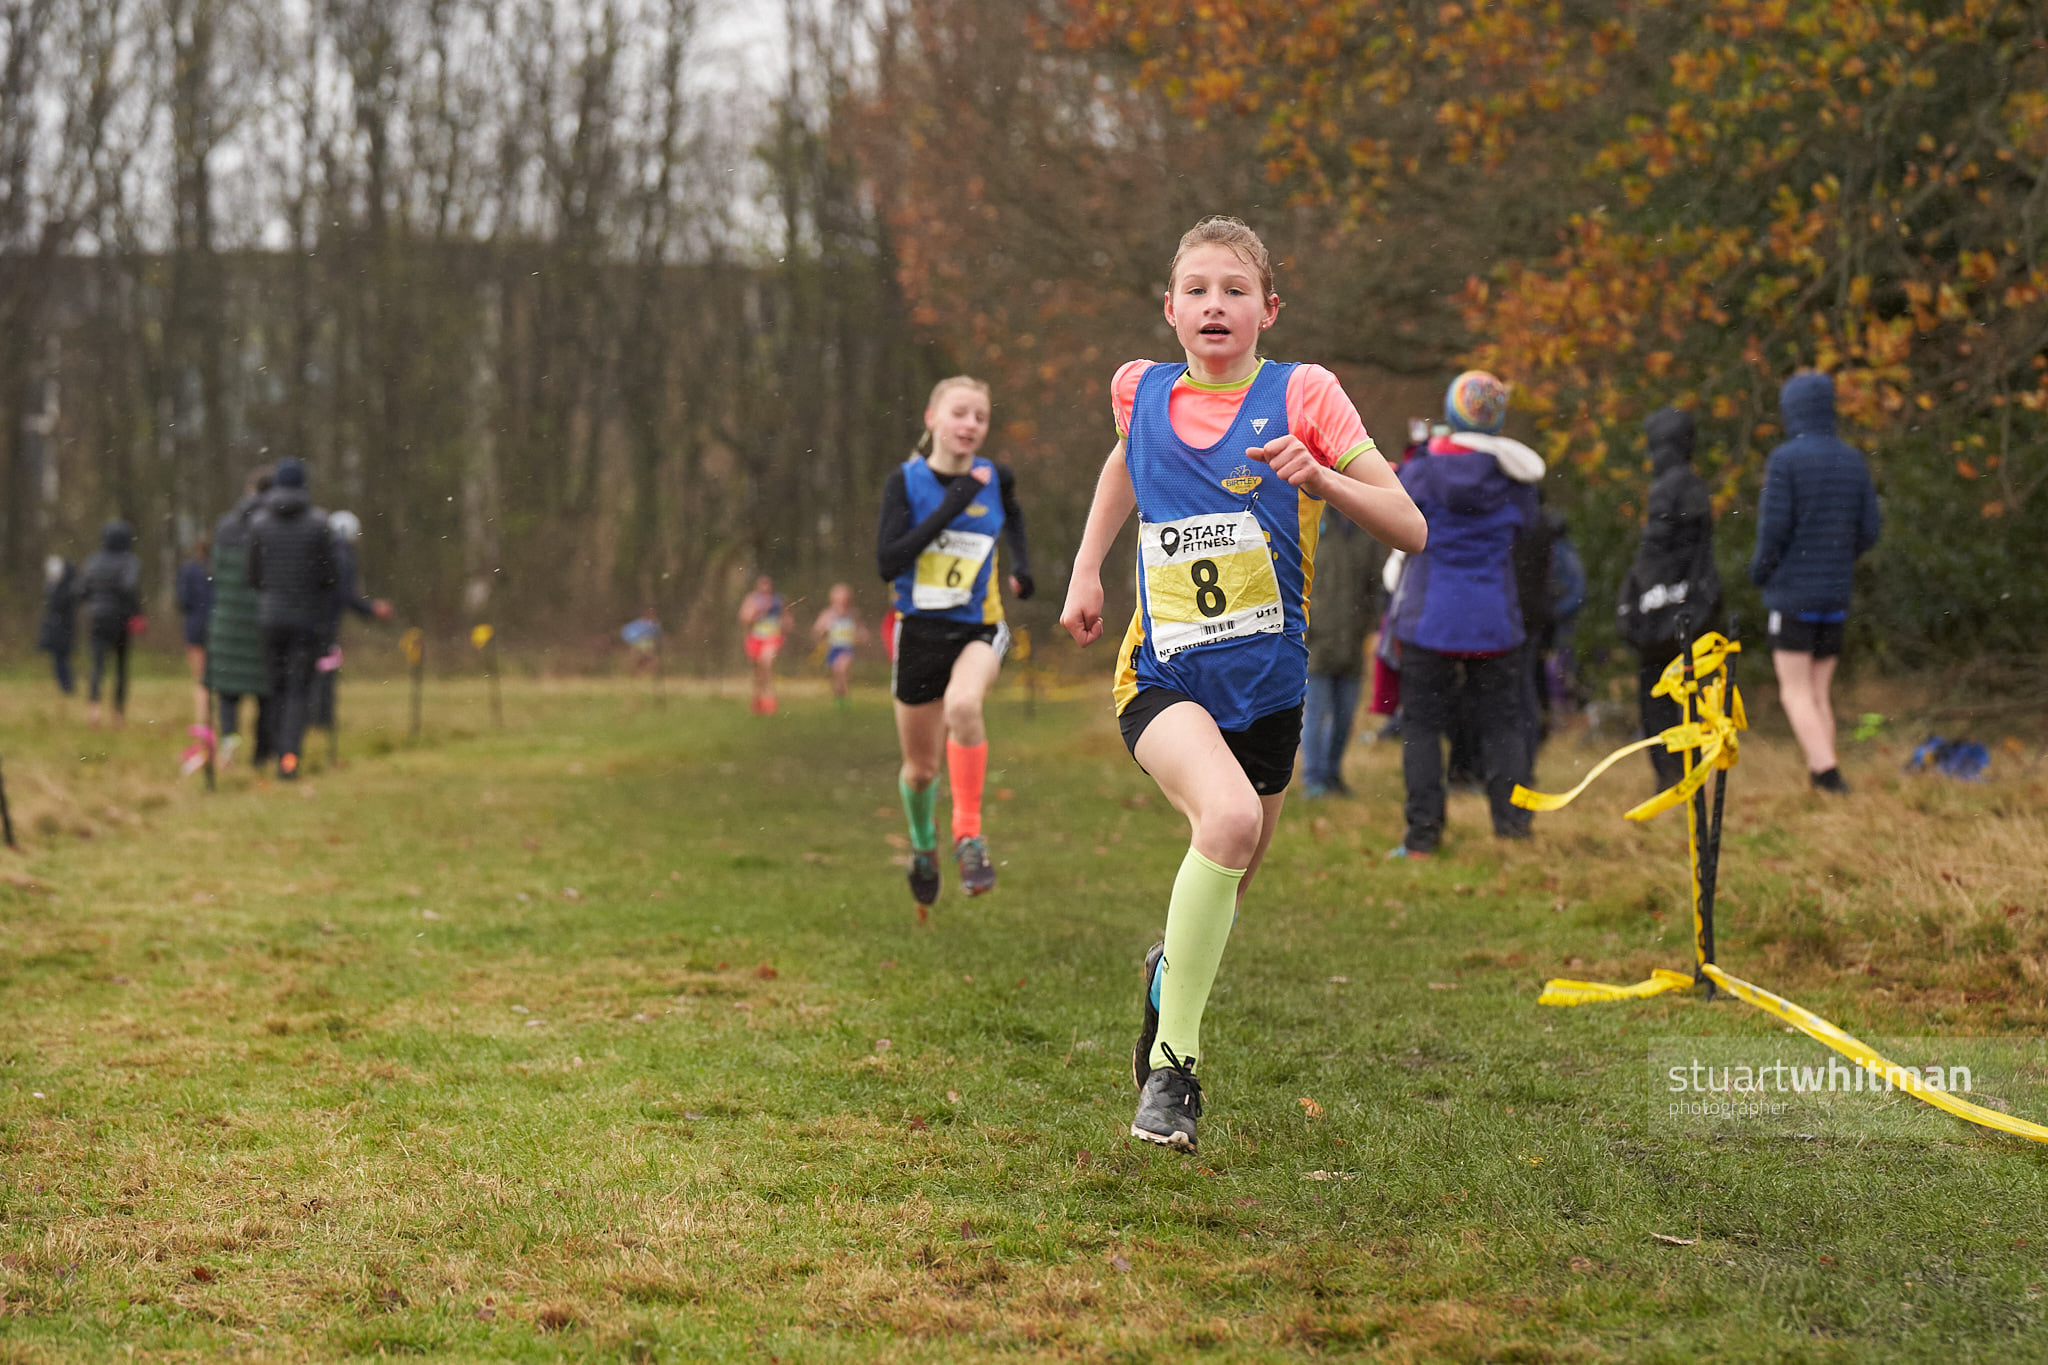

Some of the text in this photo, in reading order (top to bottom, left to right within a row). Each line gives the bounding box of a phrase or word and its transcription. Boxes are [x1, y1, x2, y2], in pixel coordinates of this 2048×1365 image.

[1226, 477, 1258, 487] BIRTLEY
[1183, 523, 1237, 542] START
[1183, 536, 1236, 554] FITNESS
[946, 557, 962, 588] 6
[1190, 559, 1227, 618] 8
[1256, 606, 1278, 619] U11
